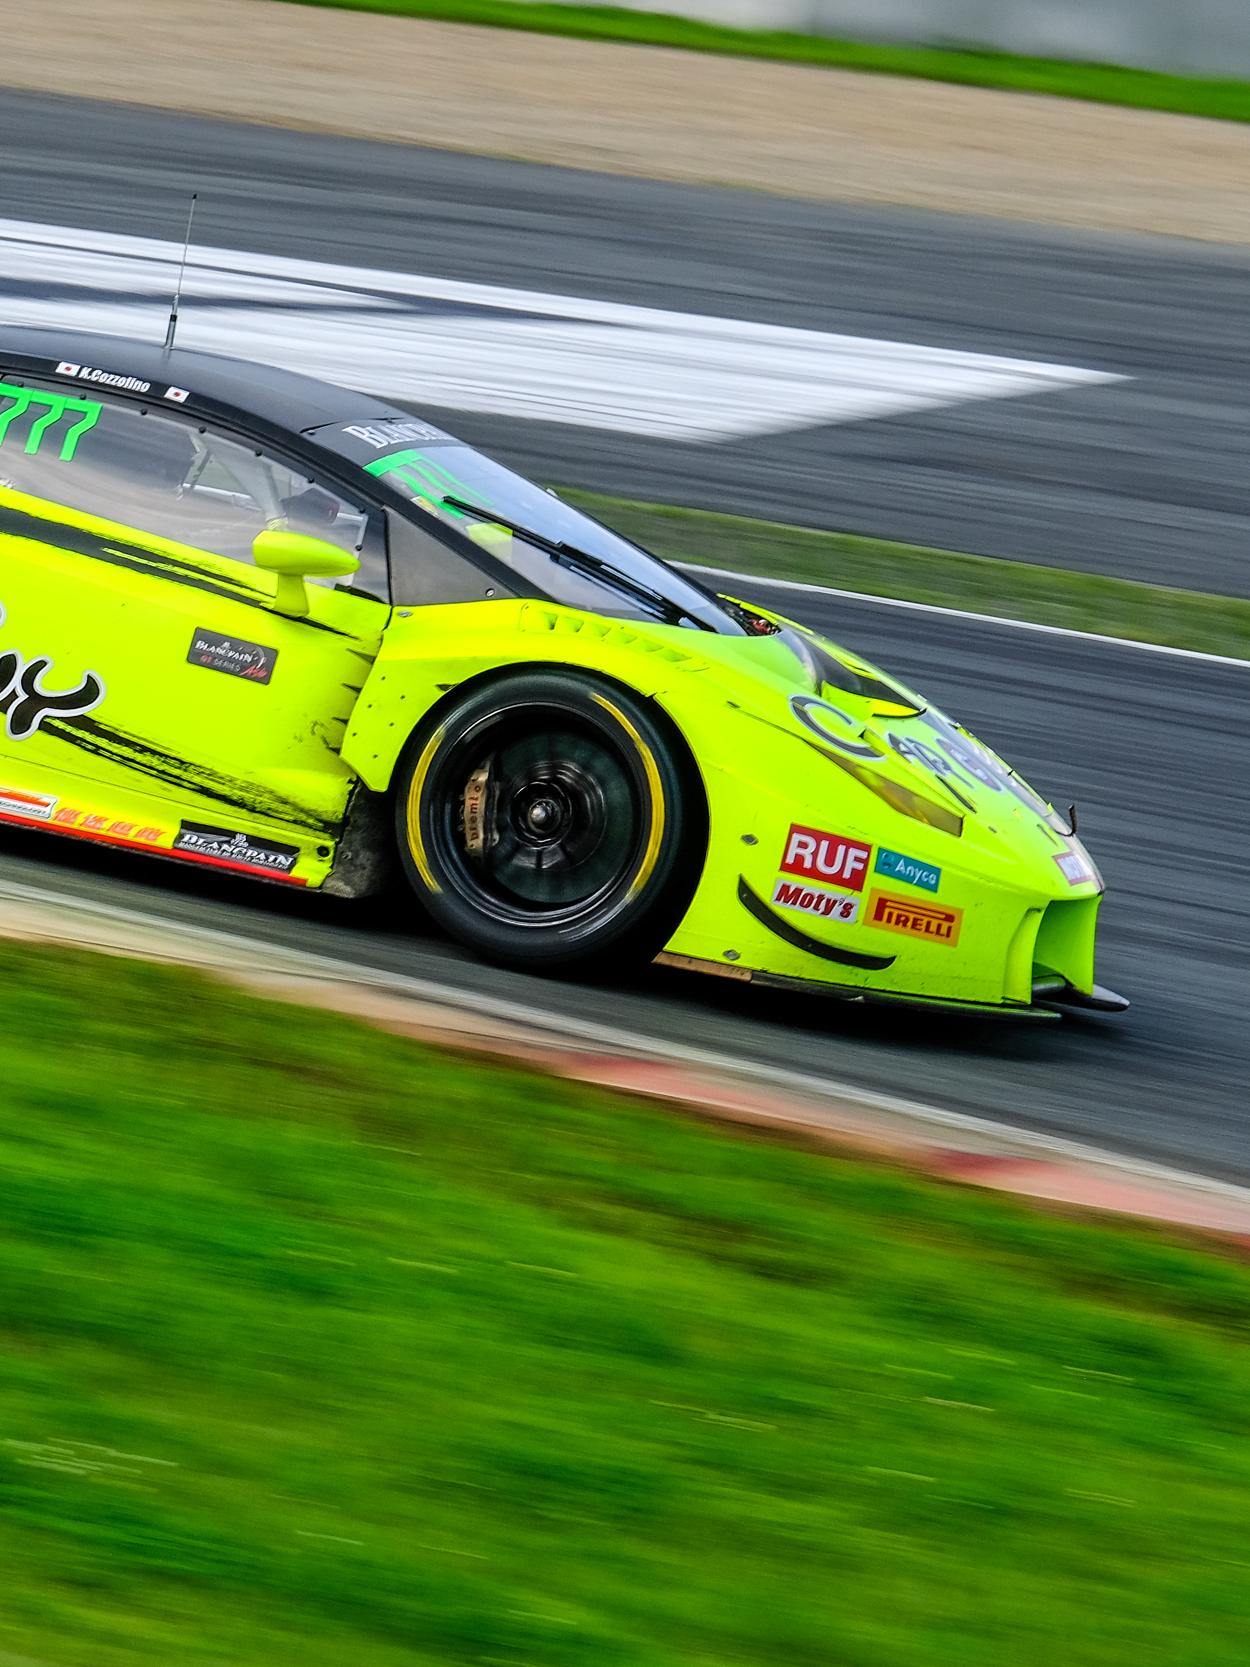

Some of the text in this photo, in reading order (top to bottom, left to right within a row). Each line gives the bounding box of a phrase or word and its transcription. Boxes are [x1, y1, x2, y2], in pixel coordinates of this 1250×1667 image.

[78, 366, 151, 393] K.Cozzolino
[195, 640, 253, 663] BLANCPAIN
[212, 658, 240, 672] SERIES
[468, 785, 481, 841] brembo
[180, 833, 295, 866] BLANCPAIN
[784, 832, 868, 879] RUF
[894, 858, 937, 885] Anyca
[774, 883, 855, 919] Moty's
[872, 897, 956, 938] PIRELLI
